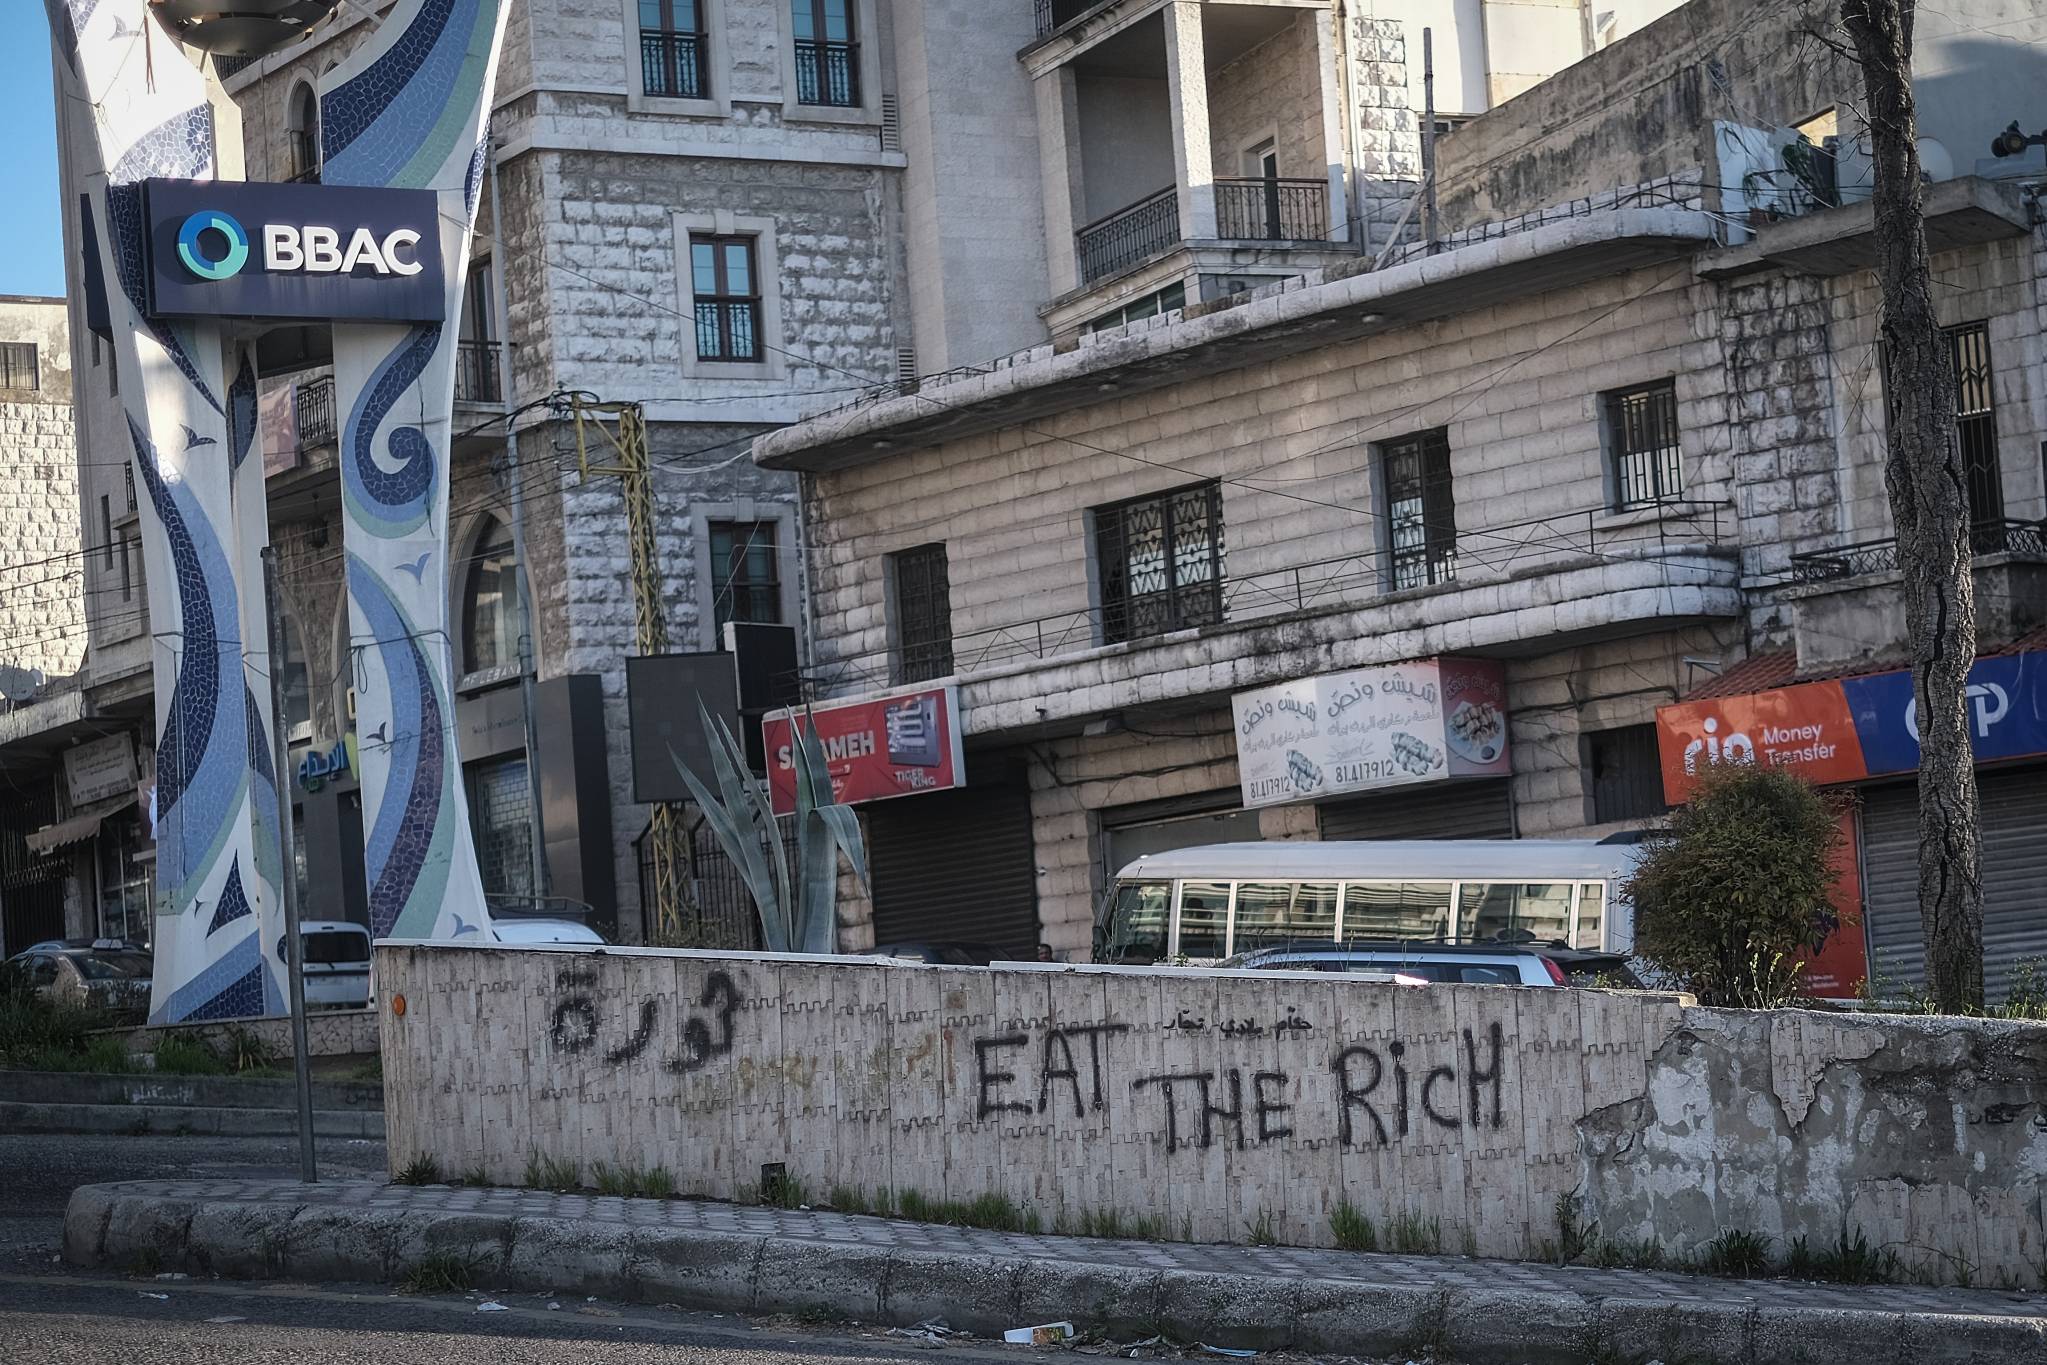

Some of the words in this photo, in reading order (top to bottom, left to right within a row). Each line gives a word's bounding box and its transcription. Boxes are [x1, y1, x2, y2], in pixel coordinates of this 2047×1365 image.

[263, 224, 424, 276] BBAC
[1763, 723, 1822, 745] Money
[1764, 743, 1836, 765] Transfer
[893, 768, 924, 782] TIGER
[911, 776, 936, 789] KING
[974, 1023, 1129, 1121] EAT
[1132, 1068, 1294, 1154] THE
